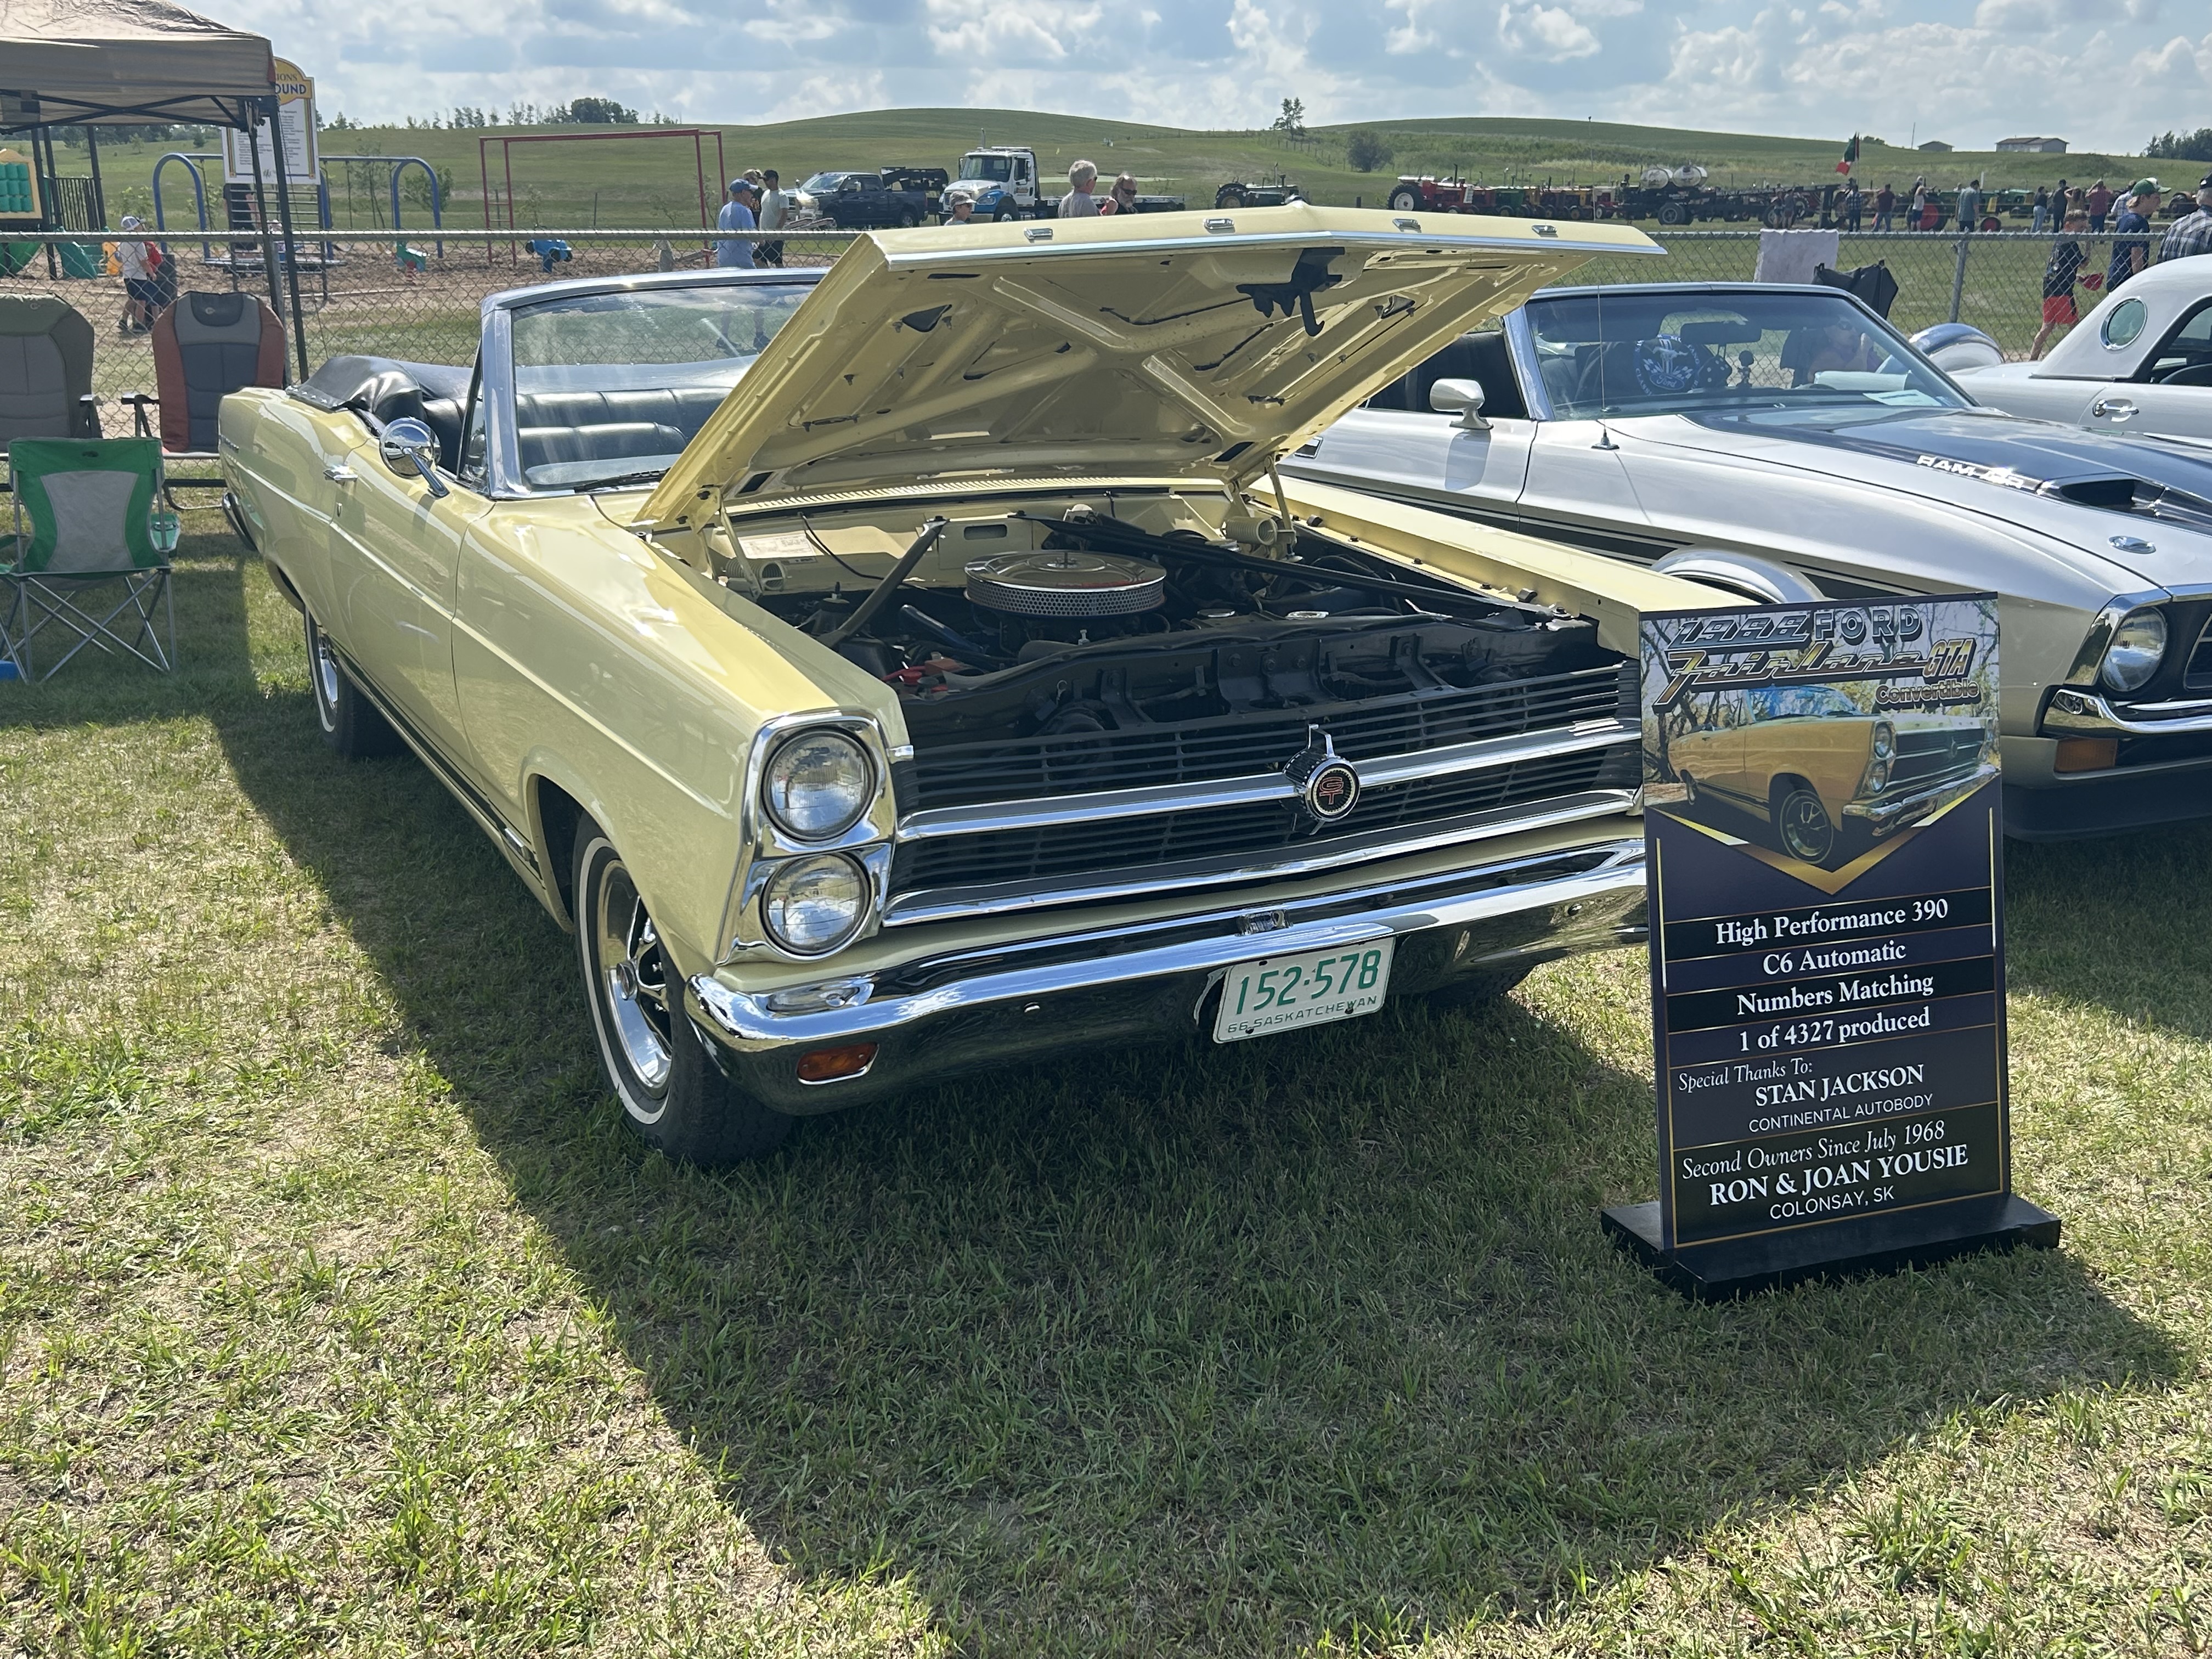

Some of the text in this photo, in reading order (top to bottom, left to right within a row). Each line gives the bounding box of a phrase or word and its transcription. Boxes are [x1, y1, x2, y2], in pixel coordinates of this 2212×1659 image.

[1656, 375, 1677, 387] Ford
[1668, 607, 1921, 650] 1966 FORD
[1654, 637, 1975, 706] Fairlane GTA
[1875, 678, 1980, 705] Convertible
[1319, 776, 1344, 805] GT
[1716, 899, 1948, 946] High Performance 390
[1763, 940, 1906, 975] C6 Automatic
[1227, 996, 1377, 1033] 66 SASKATCHEWAN
[1737, 974, 1934, 1015] Numbers Matching
[1740, 1006, 1931, 1051] 1 of 4327 produced
[1679, 1057, 1813, 1093] Special Thanks To:
[1756, 1064, 1924, 1107] STAN JACKSON
[1749, 1093, 1933, 1132] CONTINENTAL AUTOBODY
[1682, 1120, 1944, 1179] Second Owners Since July 1968
[1709, 1143, 1968, 1205] RON & JOAN YOUSIE
[1770, 1185, 1894, 1219] COLONSAY, SK
